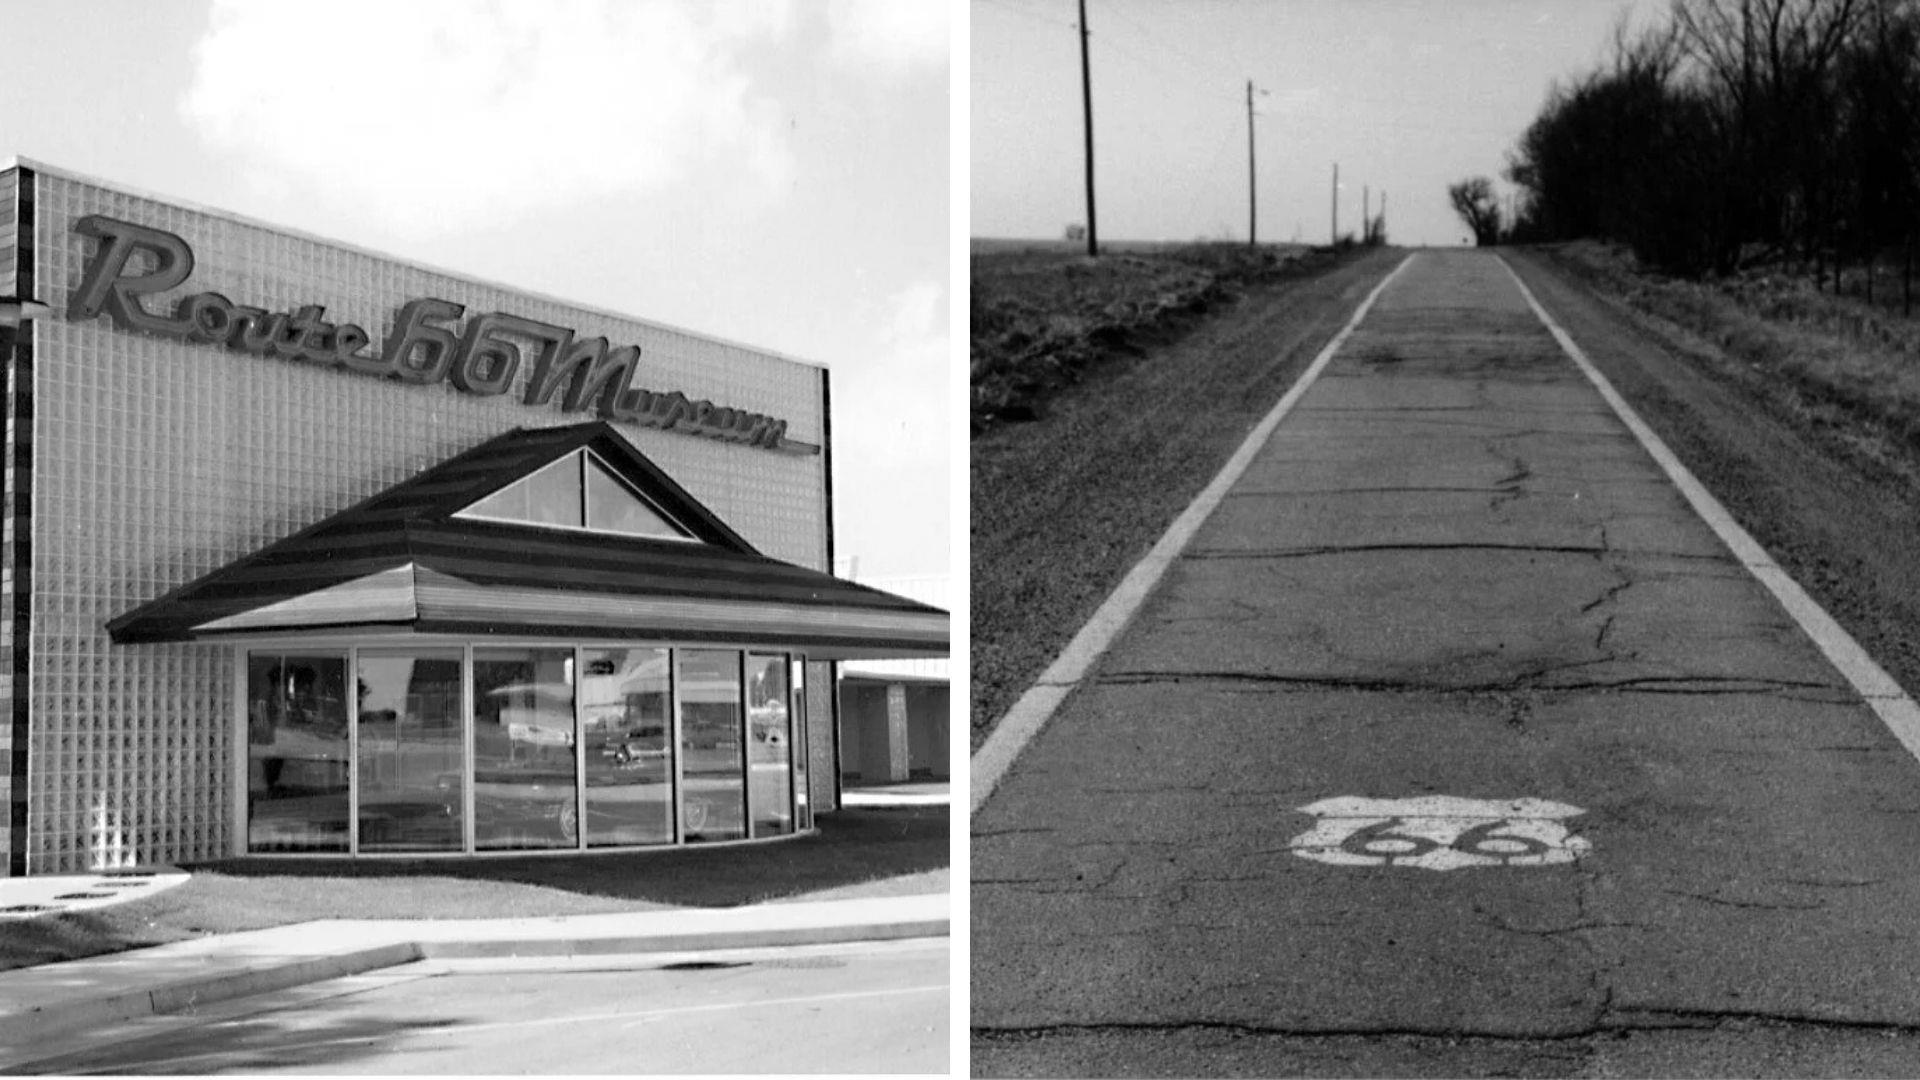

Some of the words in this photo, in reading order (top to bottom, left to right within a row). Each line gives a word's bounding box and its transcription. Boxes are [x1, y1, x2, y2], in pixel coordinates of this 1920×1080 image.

[67, 214, 372, 372] Route
[384, 298, 522, 396] 66
[523, 327, 820, 455] Museum
[1340, 816, 1550, 858] 66
